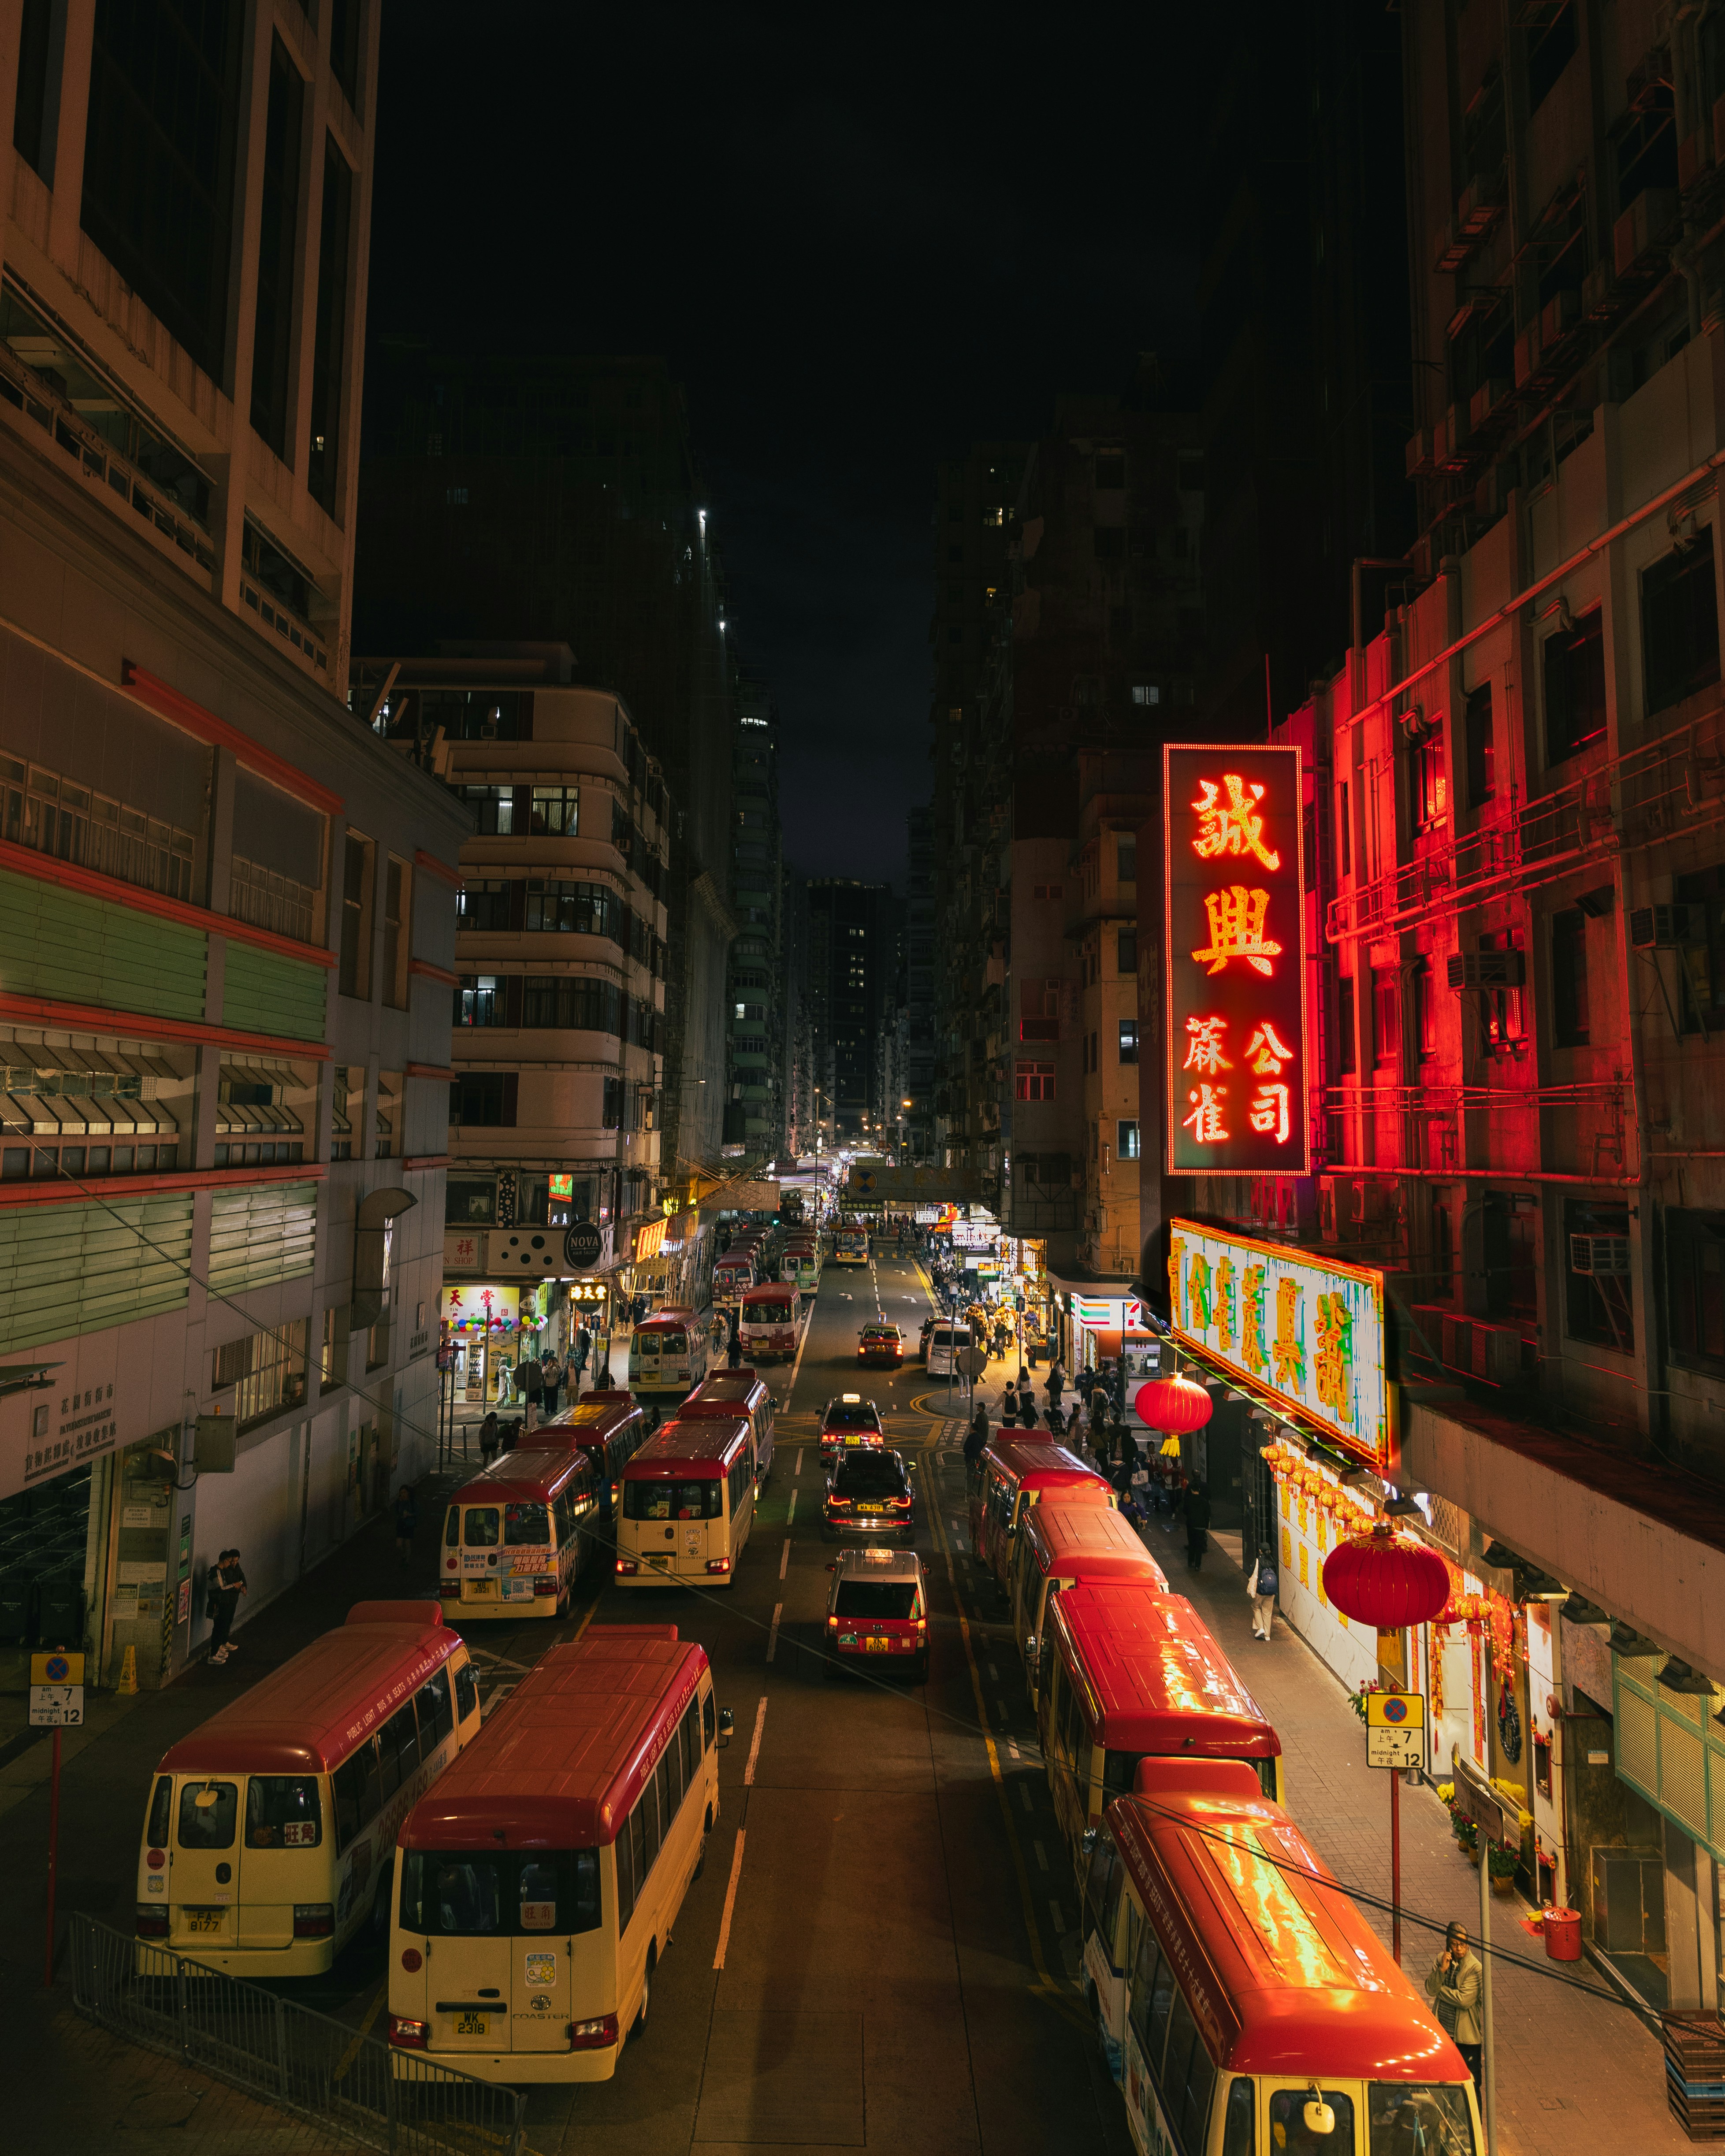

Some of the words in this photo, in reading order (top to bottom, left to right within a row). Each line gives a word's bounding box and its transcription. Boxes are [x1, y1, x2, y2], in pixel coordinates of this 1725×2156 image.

[1192, 774, 1282, 976] 誠興
[1245, 1022, 1293, 1143] 公司
[571, 1236, 599, 1247] NOVA
[571, 1285, 606, 1300] 海天堂
[659, 1508, 667, 1518] 2
[513, 1555, 547, 1564] 團隊服務
[515, 1563, 548, 1572] 力量更強
[63, 1688, 72, 1700] 7
[63, 1709, 80, 1722] 12
[347, 1721, 363, 1741] PUBLIC
[362, 1708, 375, 1726] LIGHT
[377, 1699, 387, 1713] BUS
[392, 1681, 406, 1699] SEATS
[1403, 1731, 1412, 1744] 7
[1404, 1753, 1420, 1766] 12
[640, 1763, 650, 1781] PUBLIC
[286, 1823, 314, 1843] 旺角
[1121, 1824, 1130, 1846] PUBLIC
[1130, 1846, 1141, 1865] LIGHT
[1138, 1863, 1148, 1879] BUS
[1149, 1886, 1163, 1912] SEATS
[197, 1912, 212, 1921] FA
[525, 1905, 550, 1919] 旺角
[191, 1921, 219, 1931] 8177
[465, 2012, 479, 2023] WK
[458, 2023, 484, 2034] 2318
